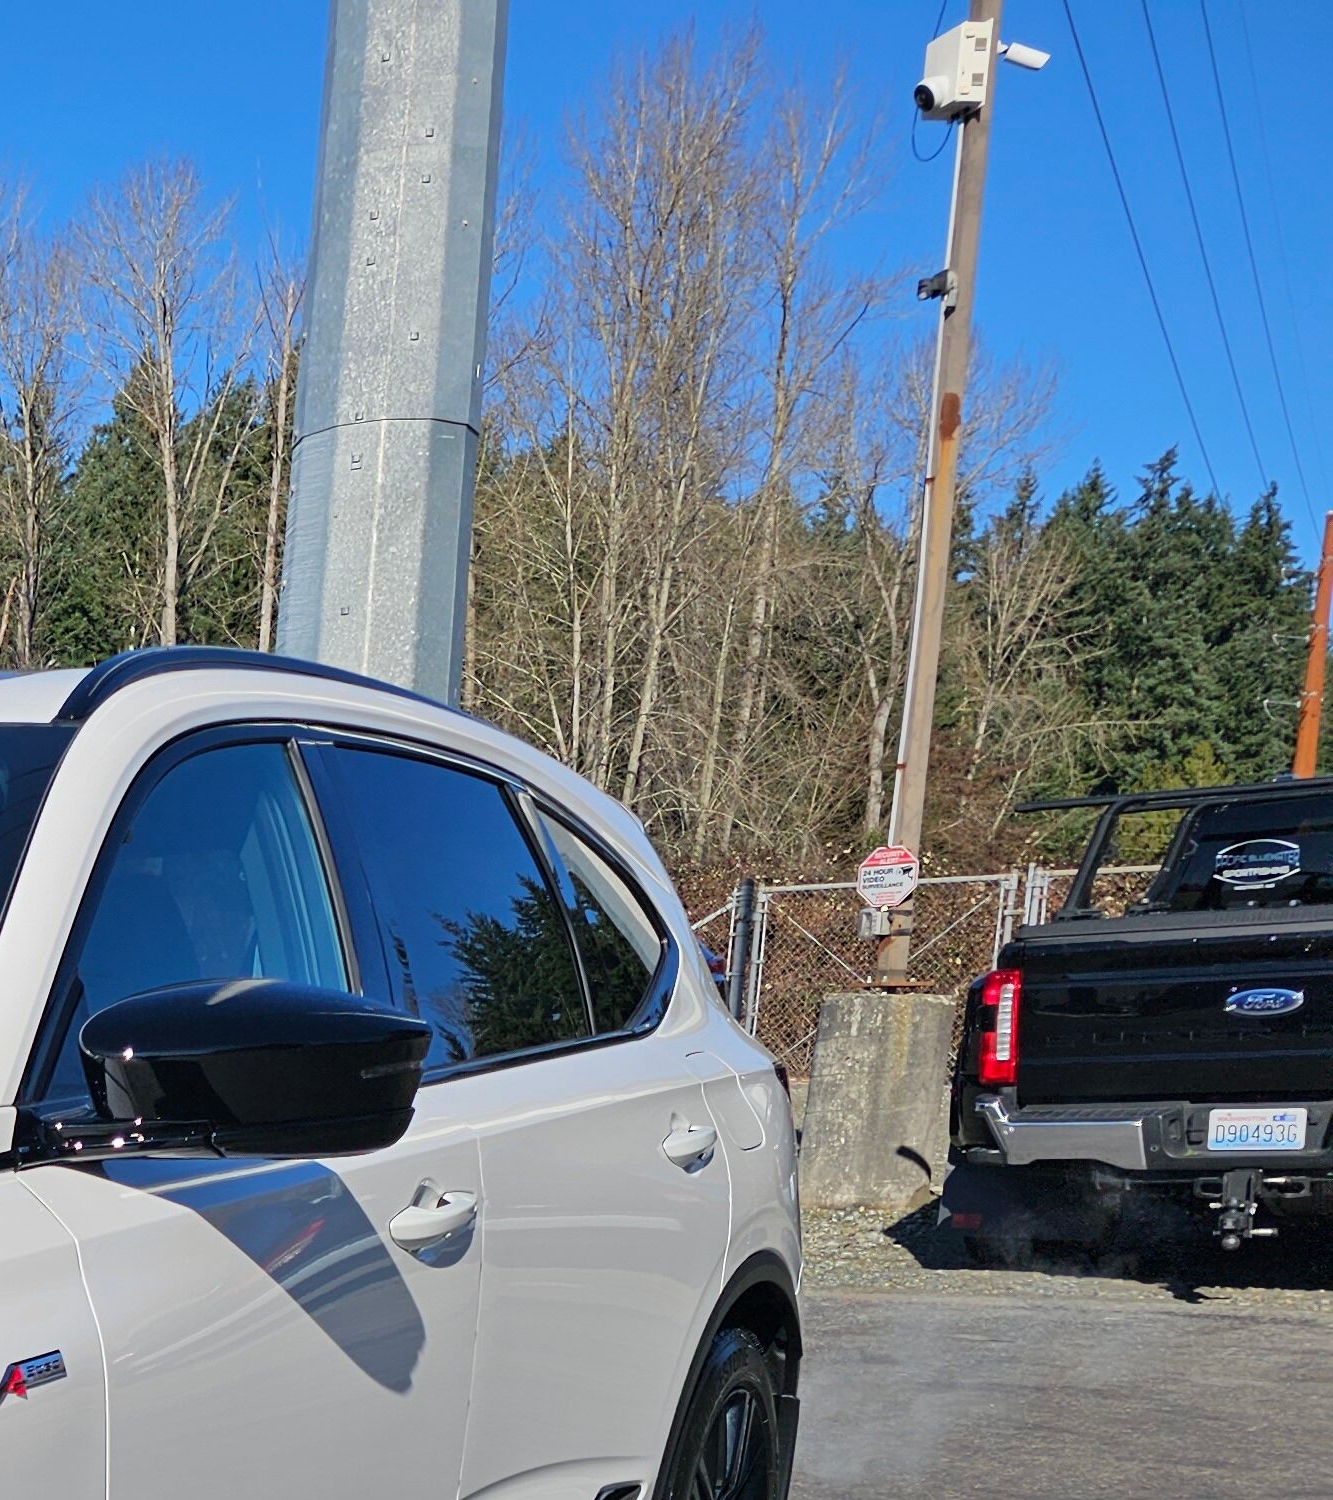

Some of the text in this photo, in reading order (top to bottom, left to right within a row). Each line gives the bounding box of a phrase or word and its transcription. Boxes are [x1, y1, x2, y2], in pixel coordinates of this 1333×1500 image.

[874, 850, 906, 859] SECURITY
[874, 868, 894, 876] HOUR
[1215, 1123, 1298, 1144] D90493G
